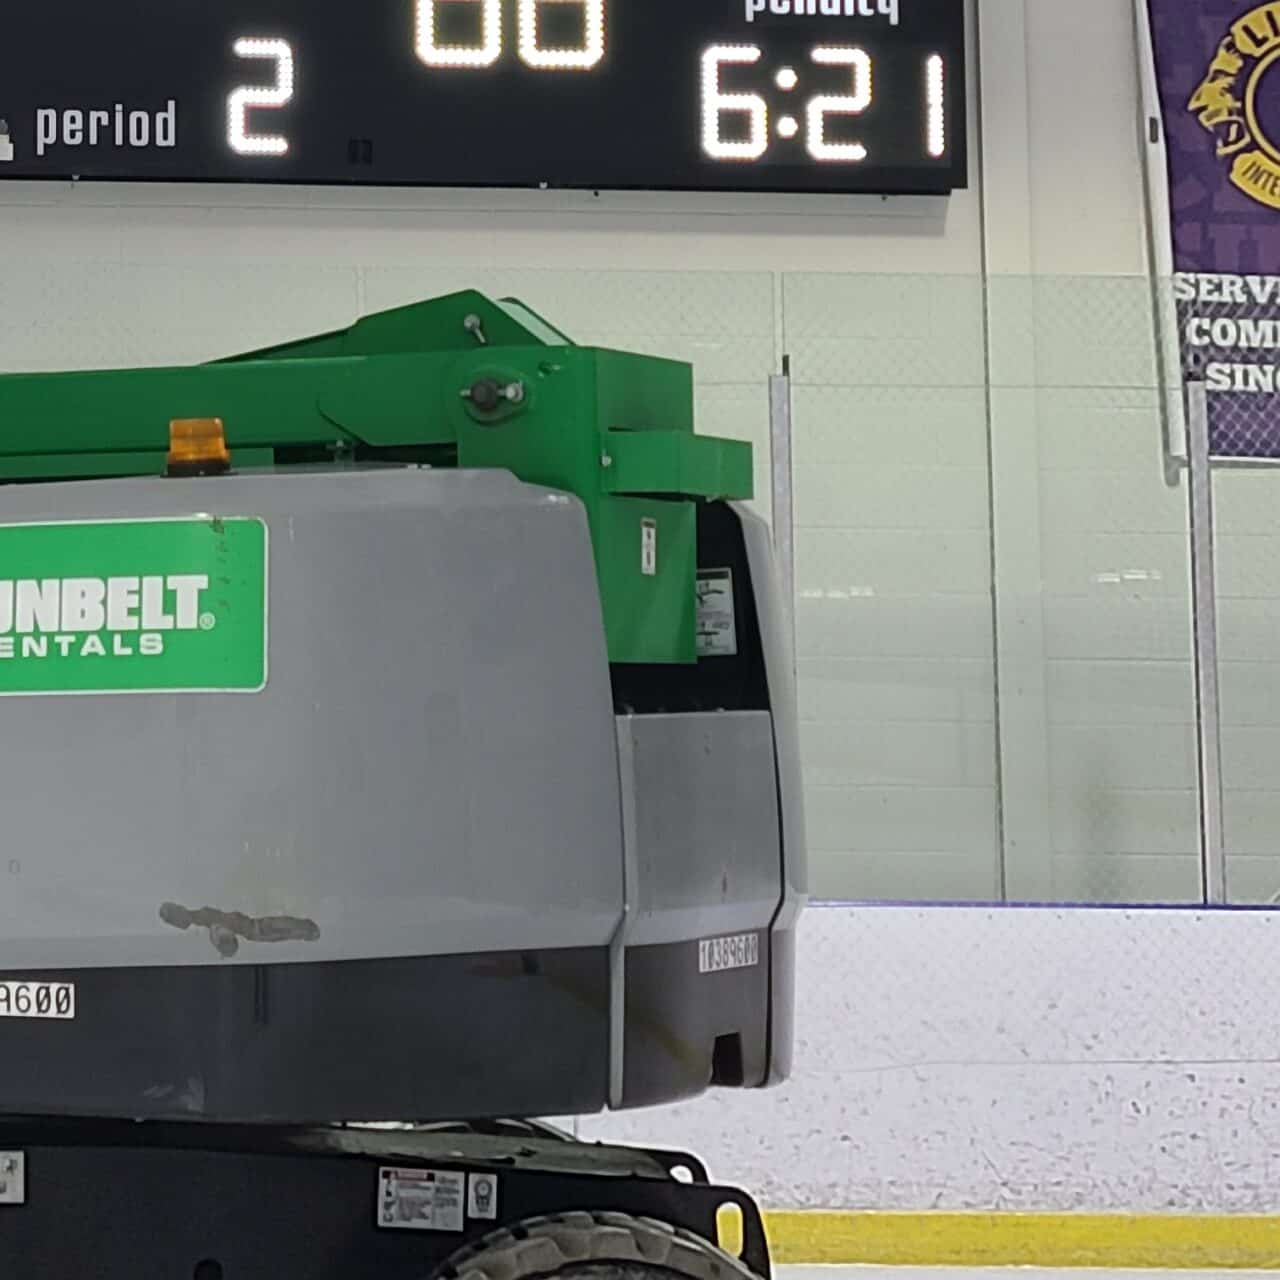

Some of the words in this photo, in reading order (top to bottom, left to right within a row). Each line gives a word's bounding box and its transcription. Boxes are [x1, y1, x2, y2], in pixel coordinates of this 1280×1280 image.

[35, 99, 177, 156] period
[228, 37, 295, 156] 2
[1172, 272, 1280, 303] SERV
[1205, 361, 1280, 392] SIN
